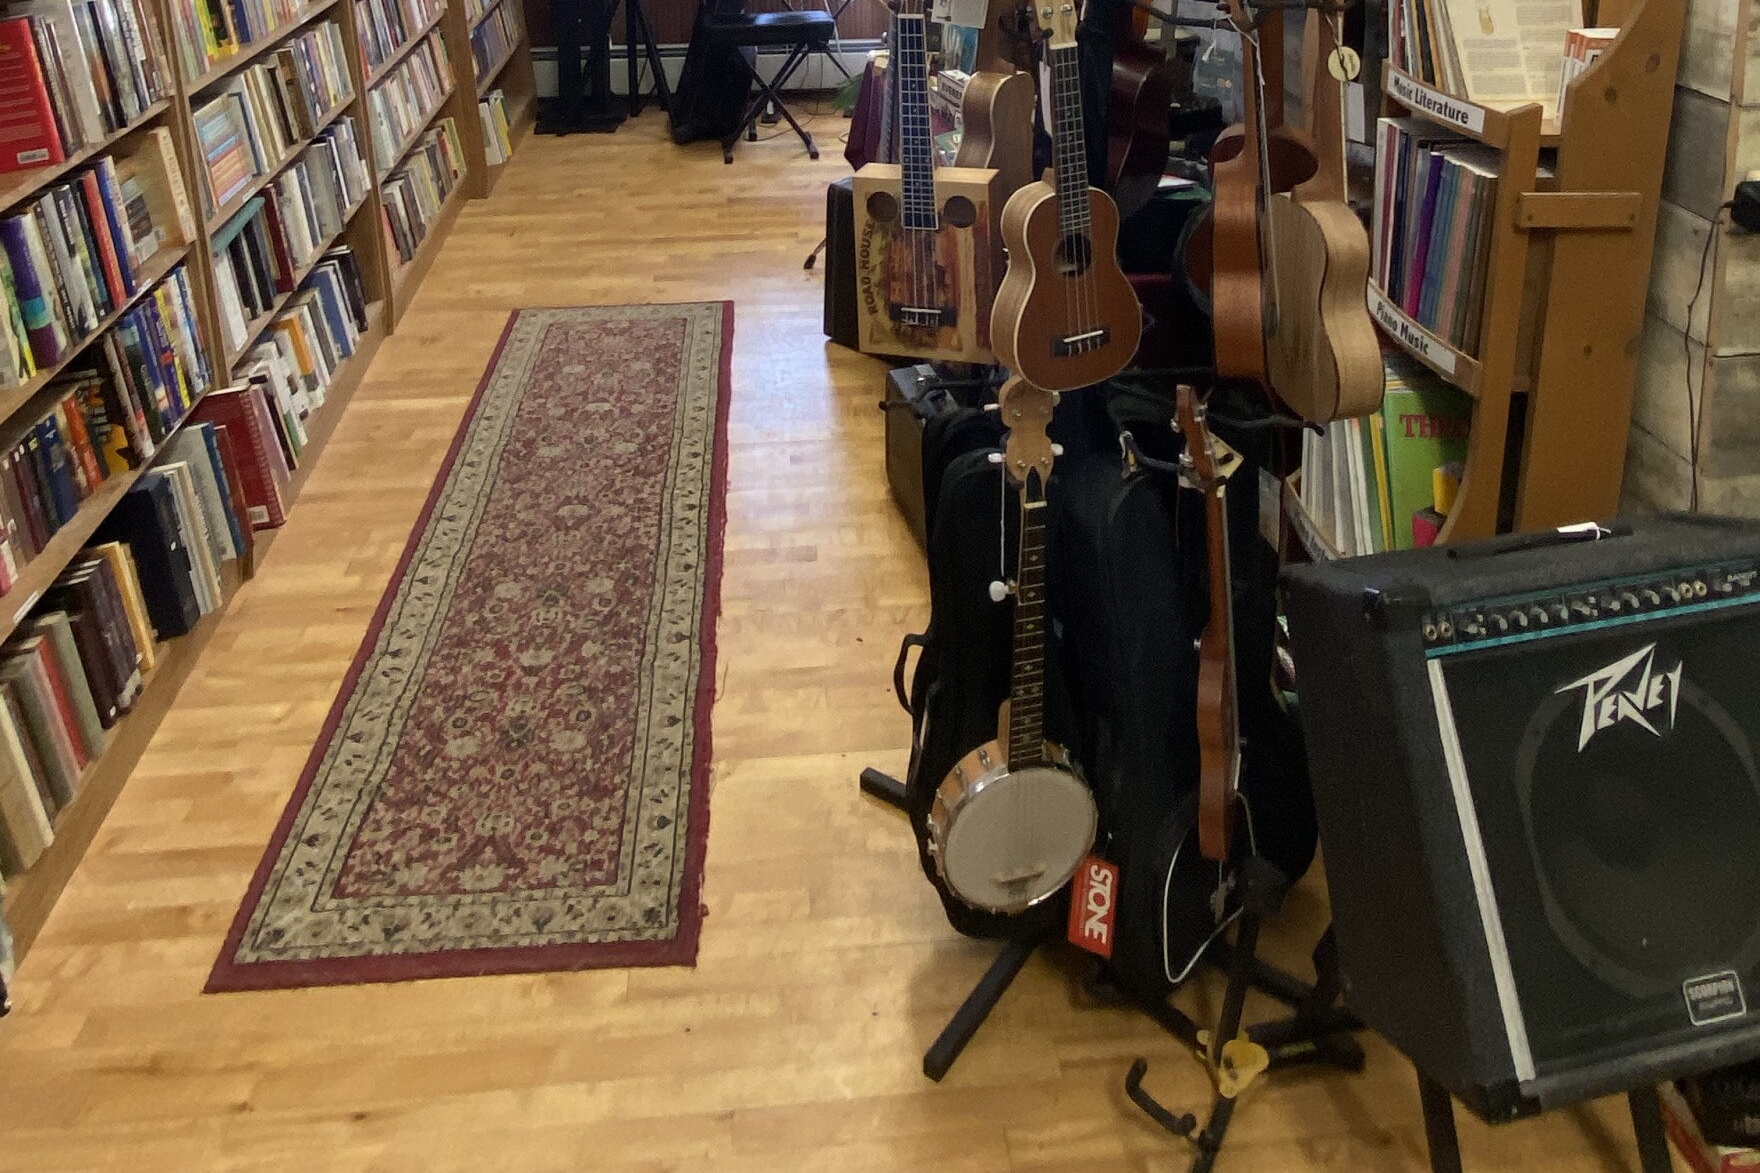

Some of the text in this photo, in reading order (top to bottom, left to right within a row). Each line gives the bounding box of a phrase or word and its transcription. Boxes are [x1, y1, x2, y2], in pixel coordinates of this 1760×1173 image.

[1394, 76, 1469, 124] Music Literature
[861, 276, 878, 316] ROAD
[1376, 301, 1429, 355] Piano Music
[1554, 642, 1682, 753] PEAVEY
[1085, 865, 1113, 944] STONE
